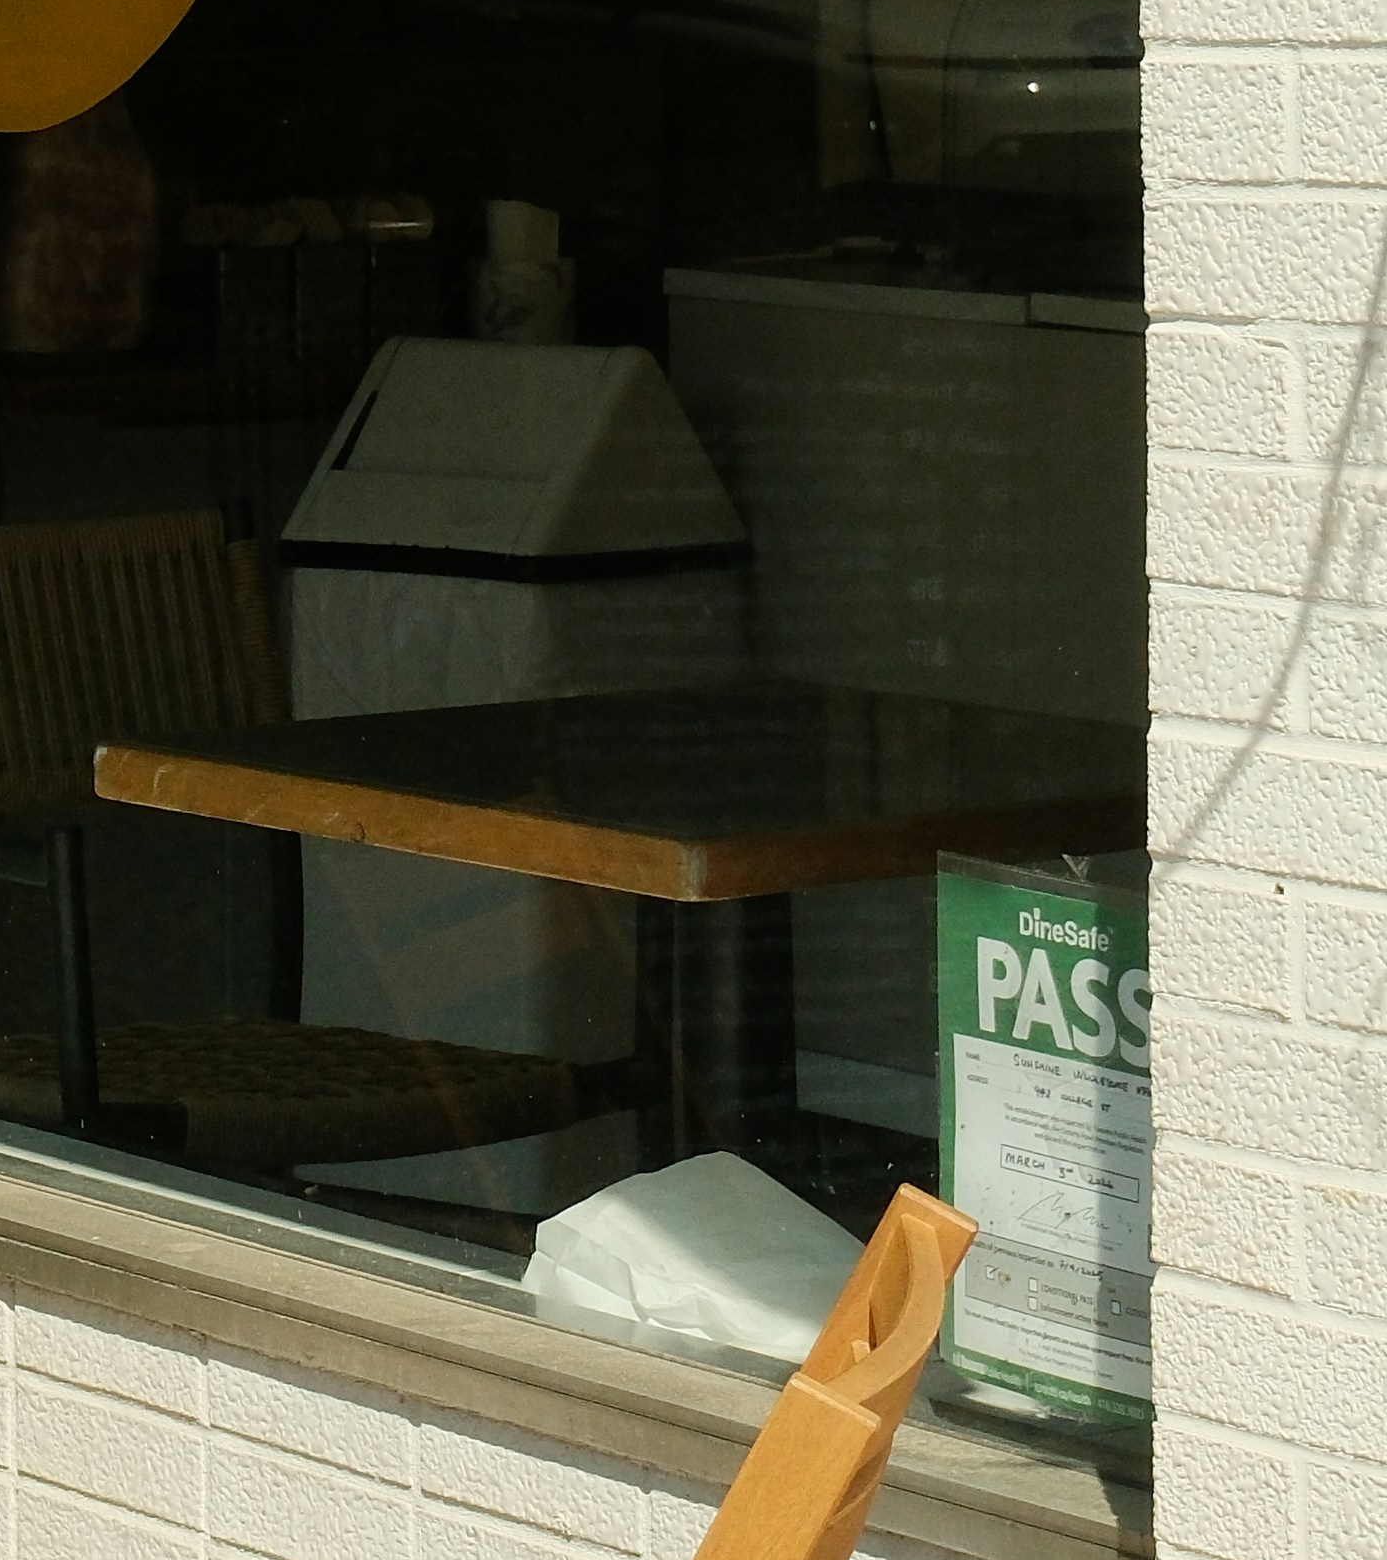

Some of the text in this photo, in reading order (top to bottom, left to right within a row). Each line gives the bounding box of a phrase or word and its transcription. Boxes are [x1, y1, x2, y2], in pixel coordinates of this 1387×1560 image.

[1019, 908, 1109, 952] DineSafe
[977, 936, 1151, 1069] PASS
[1005, 1151, 1045, 1170] MARCH
